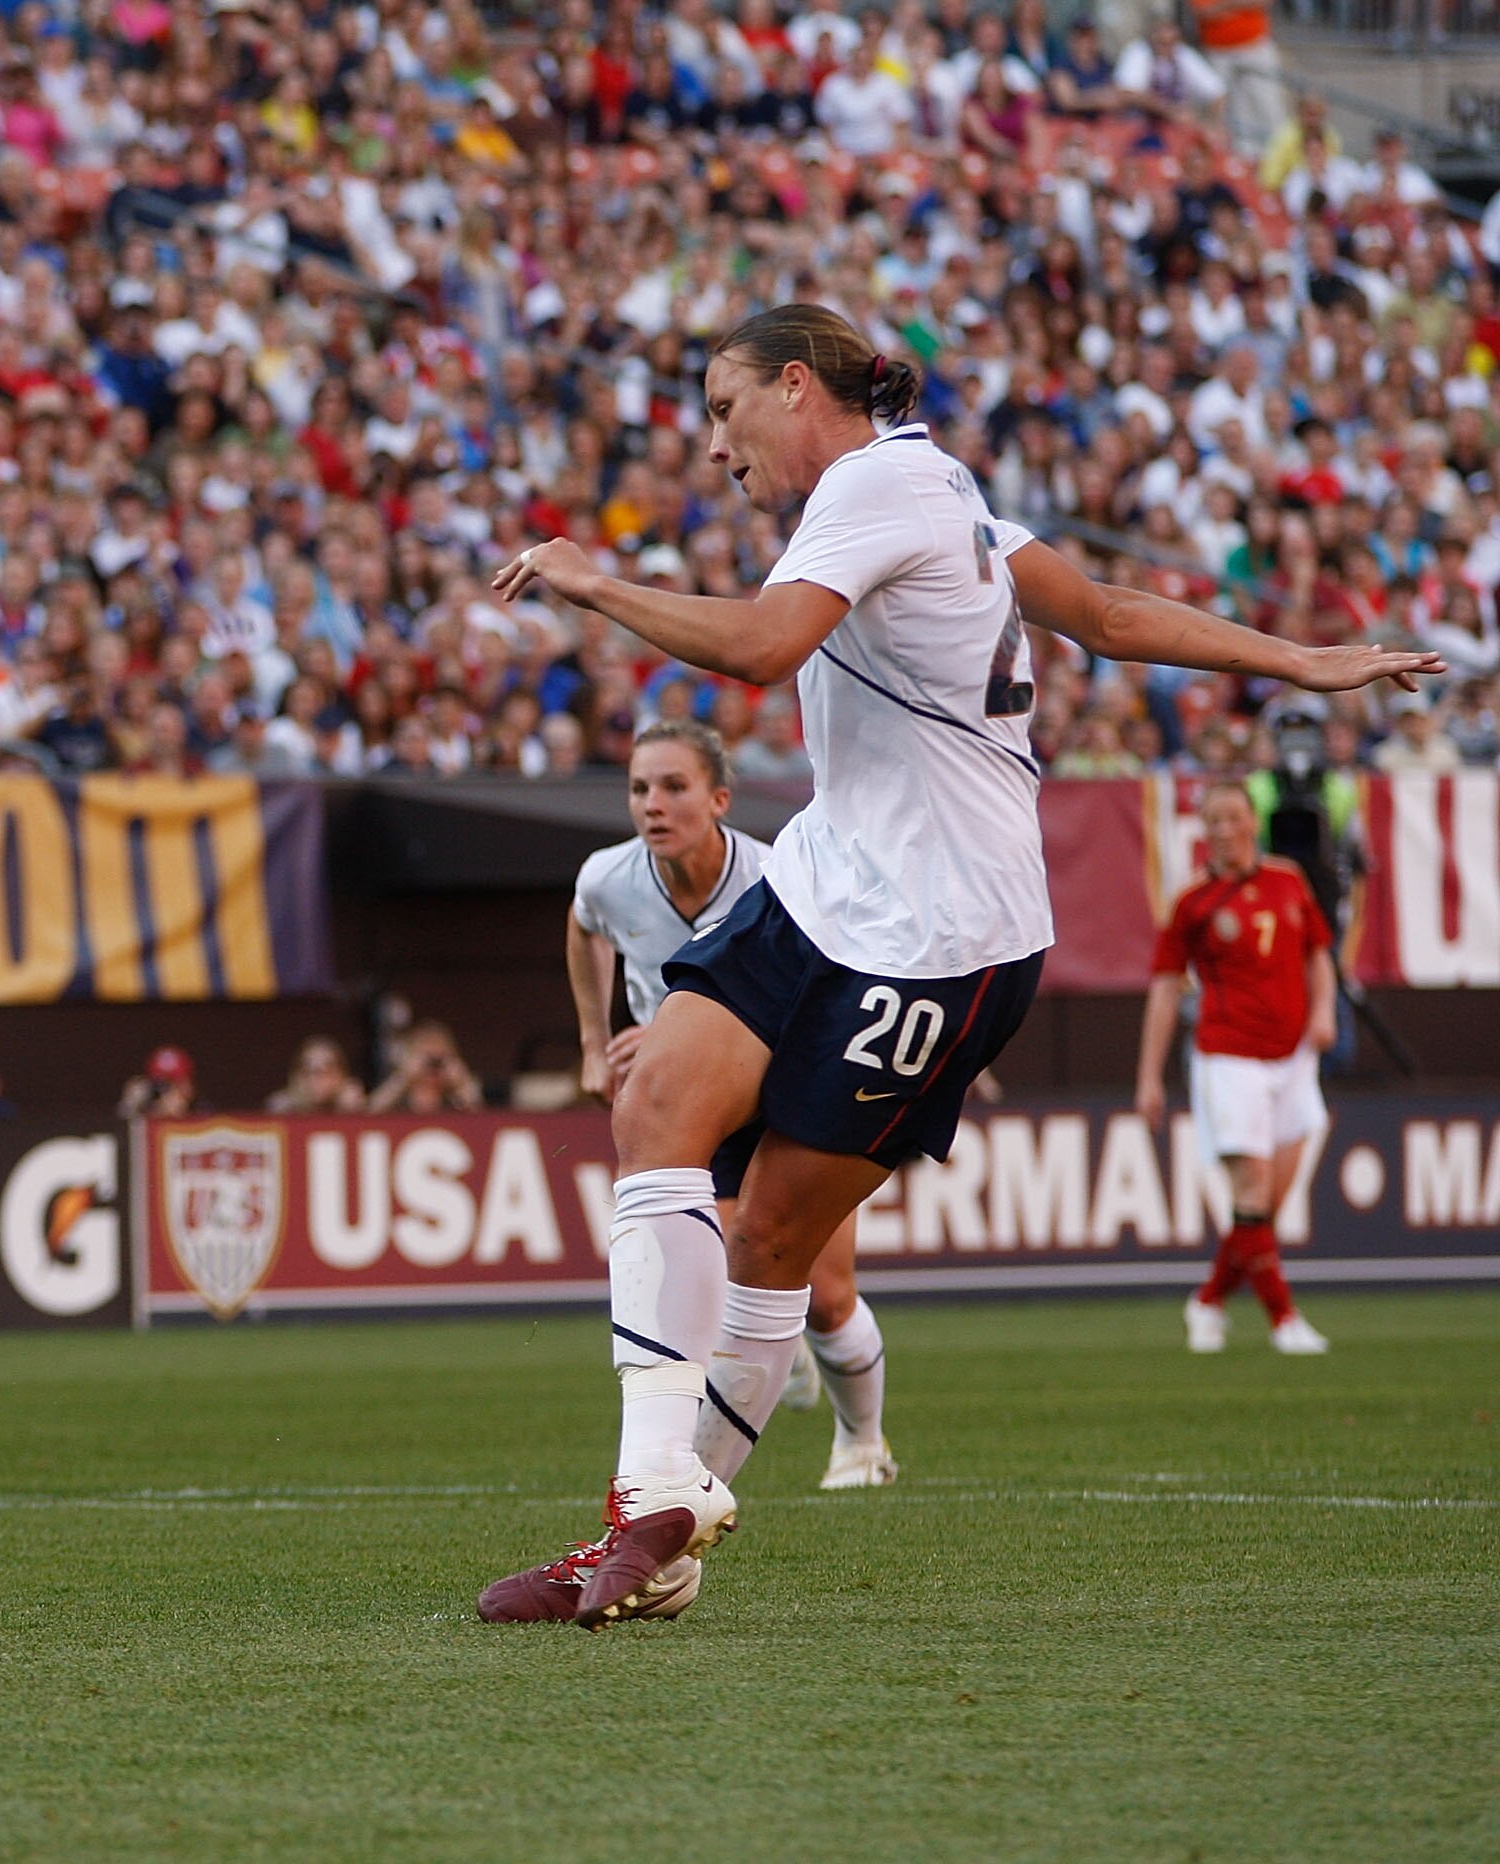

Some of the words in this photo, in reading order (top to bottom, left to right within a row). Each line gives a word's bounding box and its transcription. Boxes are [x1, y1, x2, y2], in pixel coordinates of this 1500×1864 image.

[1254, 910, 1278, 957] 7
[843, 985, 944, 1076] 20
[306, 1127, 564, 1269] USA
[856, 1110, 1329, 1256] ERMANY
